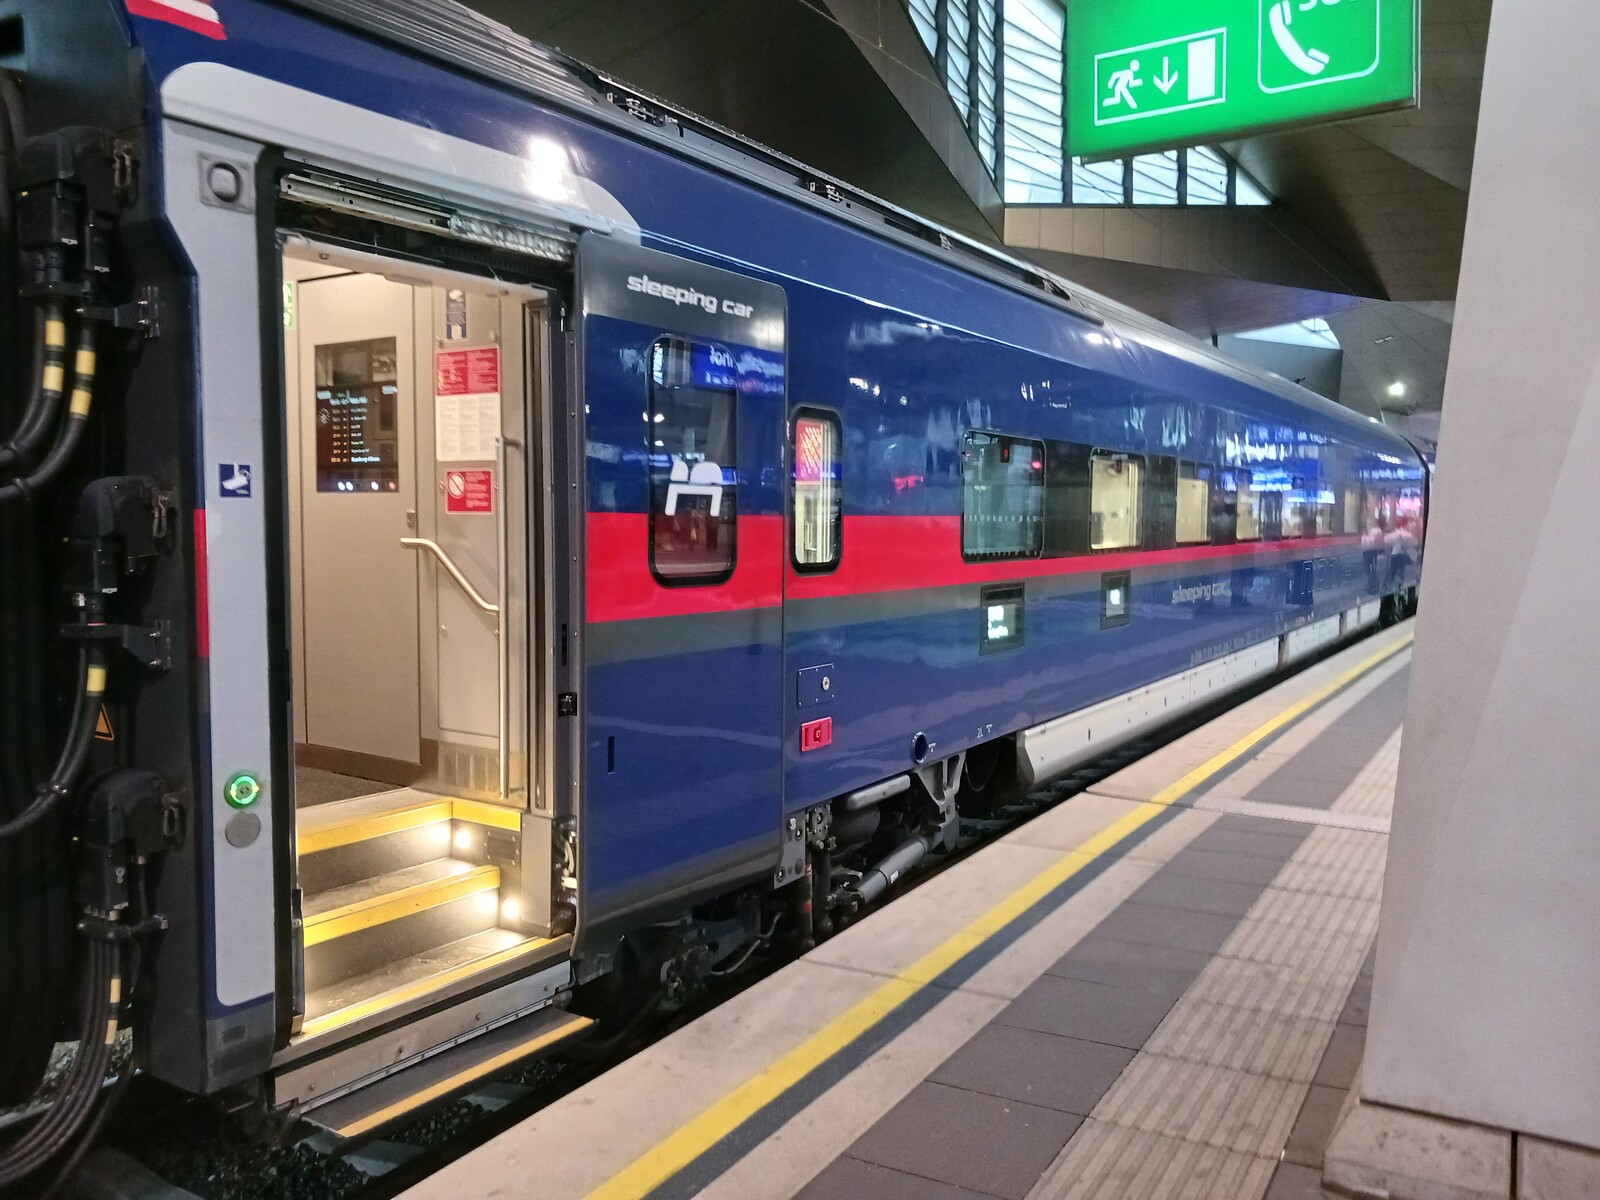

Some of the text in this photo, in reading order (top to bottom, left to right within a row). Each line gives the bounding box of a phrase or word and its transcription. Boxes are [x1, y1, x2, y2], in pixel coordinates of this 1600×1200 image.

[626, 274, 754, 318] sleeping car
[1172, 582, 1211, 604] sleeping
